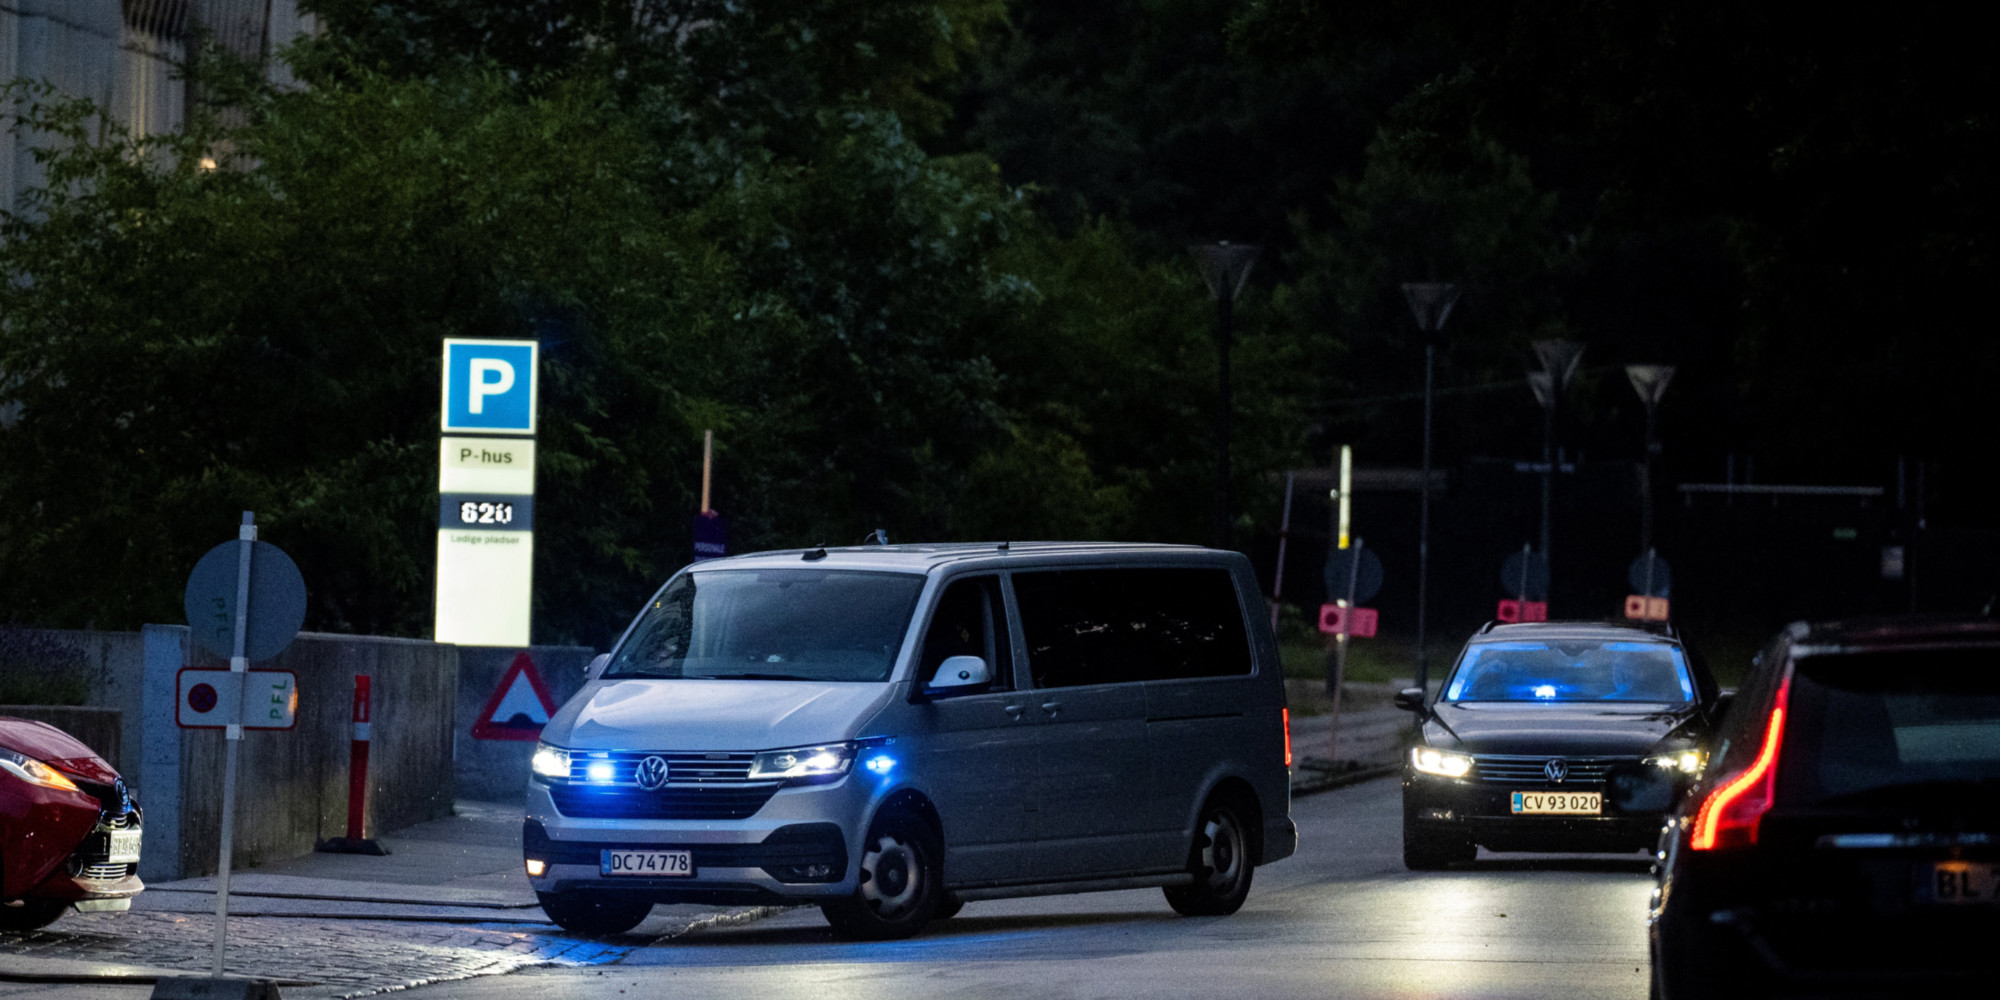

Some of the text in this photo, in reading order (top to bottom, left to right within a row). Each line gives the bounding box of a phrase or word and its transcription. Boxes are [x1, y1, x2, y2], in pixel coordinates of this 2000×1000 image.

[468, 357, 515, 414] P
[460, 448, 513, 464] P-hus
[450, 534, 520, 545] Ledige pladser
[269, 679, 287, 720] PFL
[1524, 796, 1599, 810] CV 93 020
[1938, 869, 1979, 898] BL
